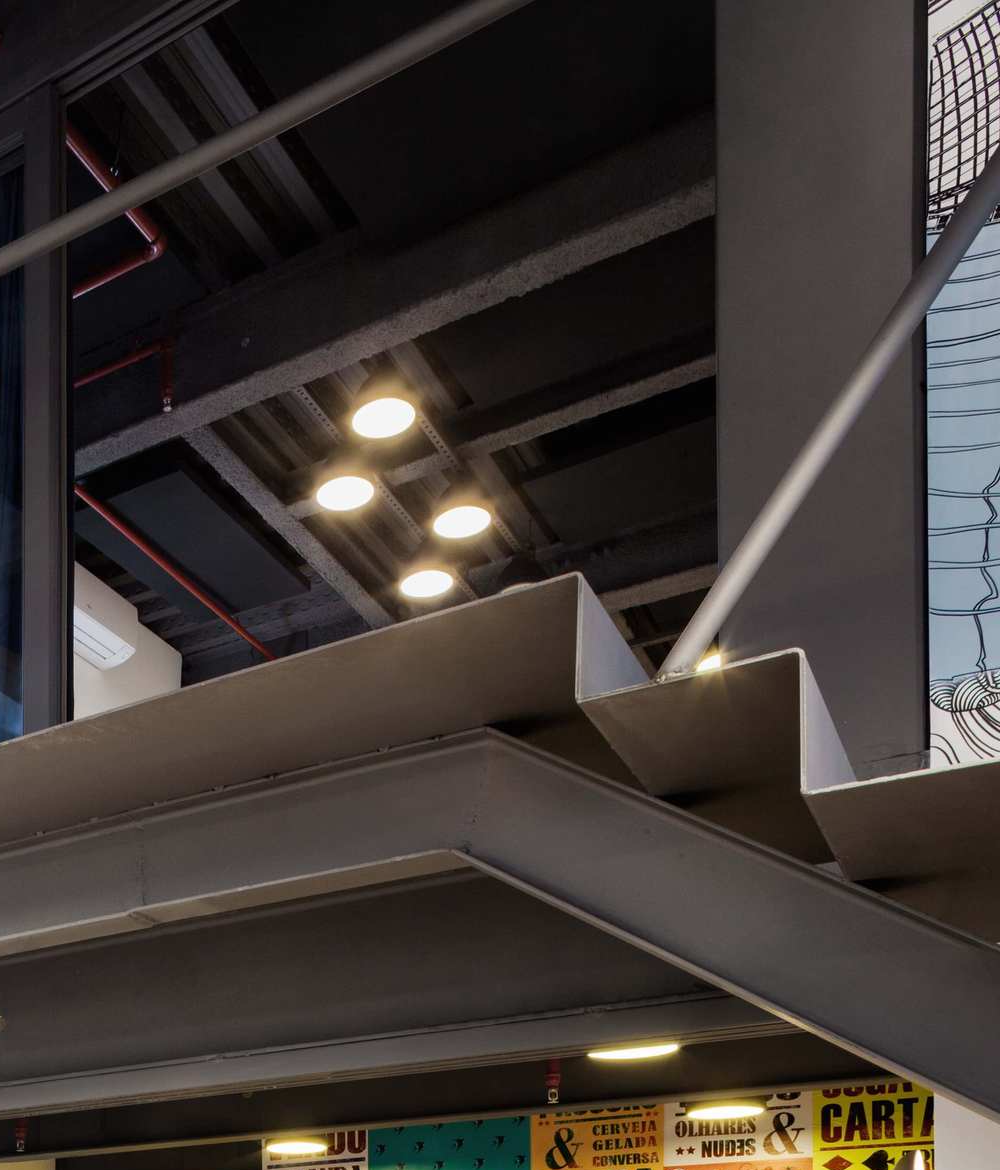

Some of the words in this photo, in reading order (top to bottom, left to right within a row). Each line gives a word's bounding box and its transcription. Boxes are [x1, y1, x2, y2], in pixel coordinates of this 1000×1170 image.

[592, 1120, 657, 1136] CERVEJA
[675, 1118, 756, 1138] OLHARES
[763, 1112, 805, 1155] &
[545, 1127, 584, 1170] &
[592, 1136, 658, 1151] GELADA
[701, 1139, 756, 1158] NUDES
[592, 1152, 660, 1167] CONVERSA
